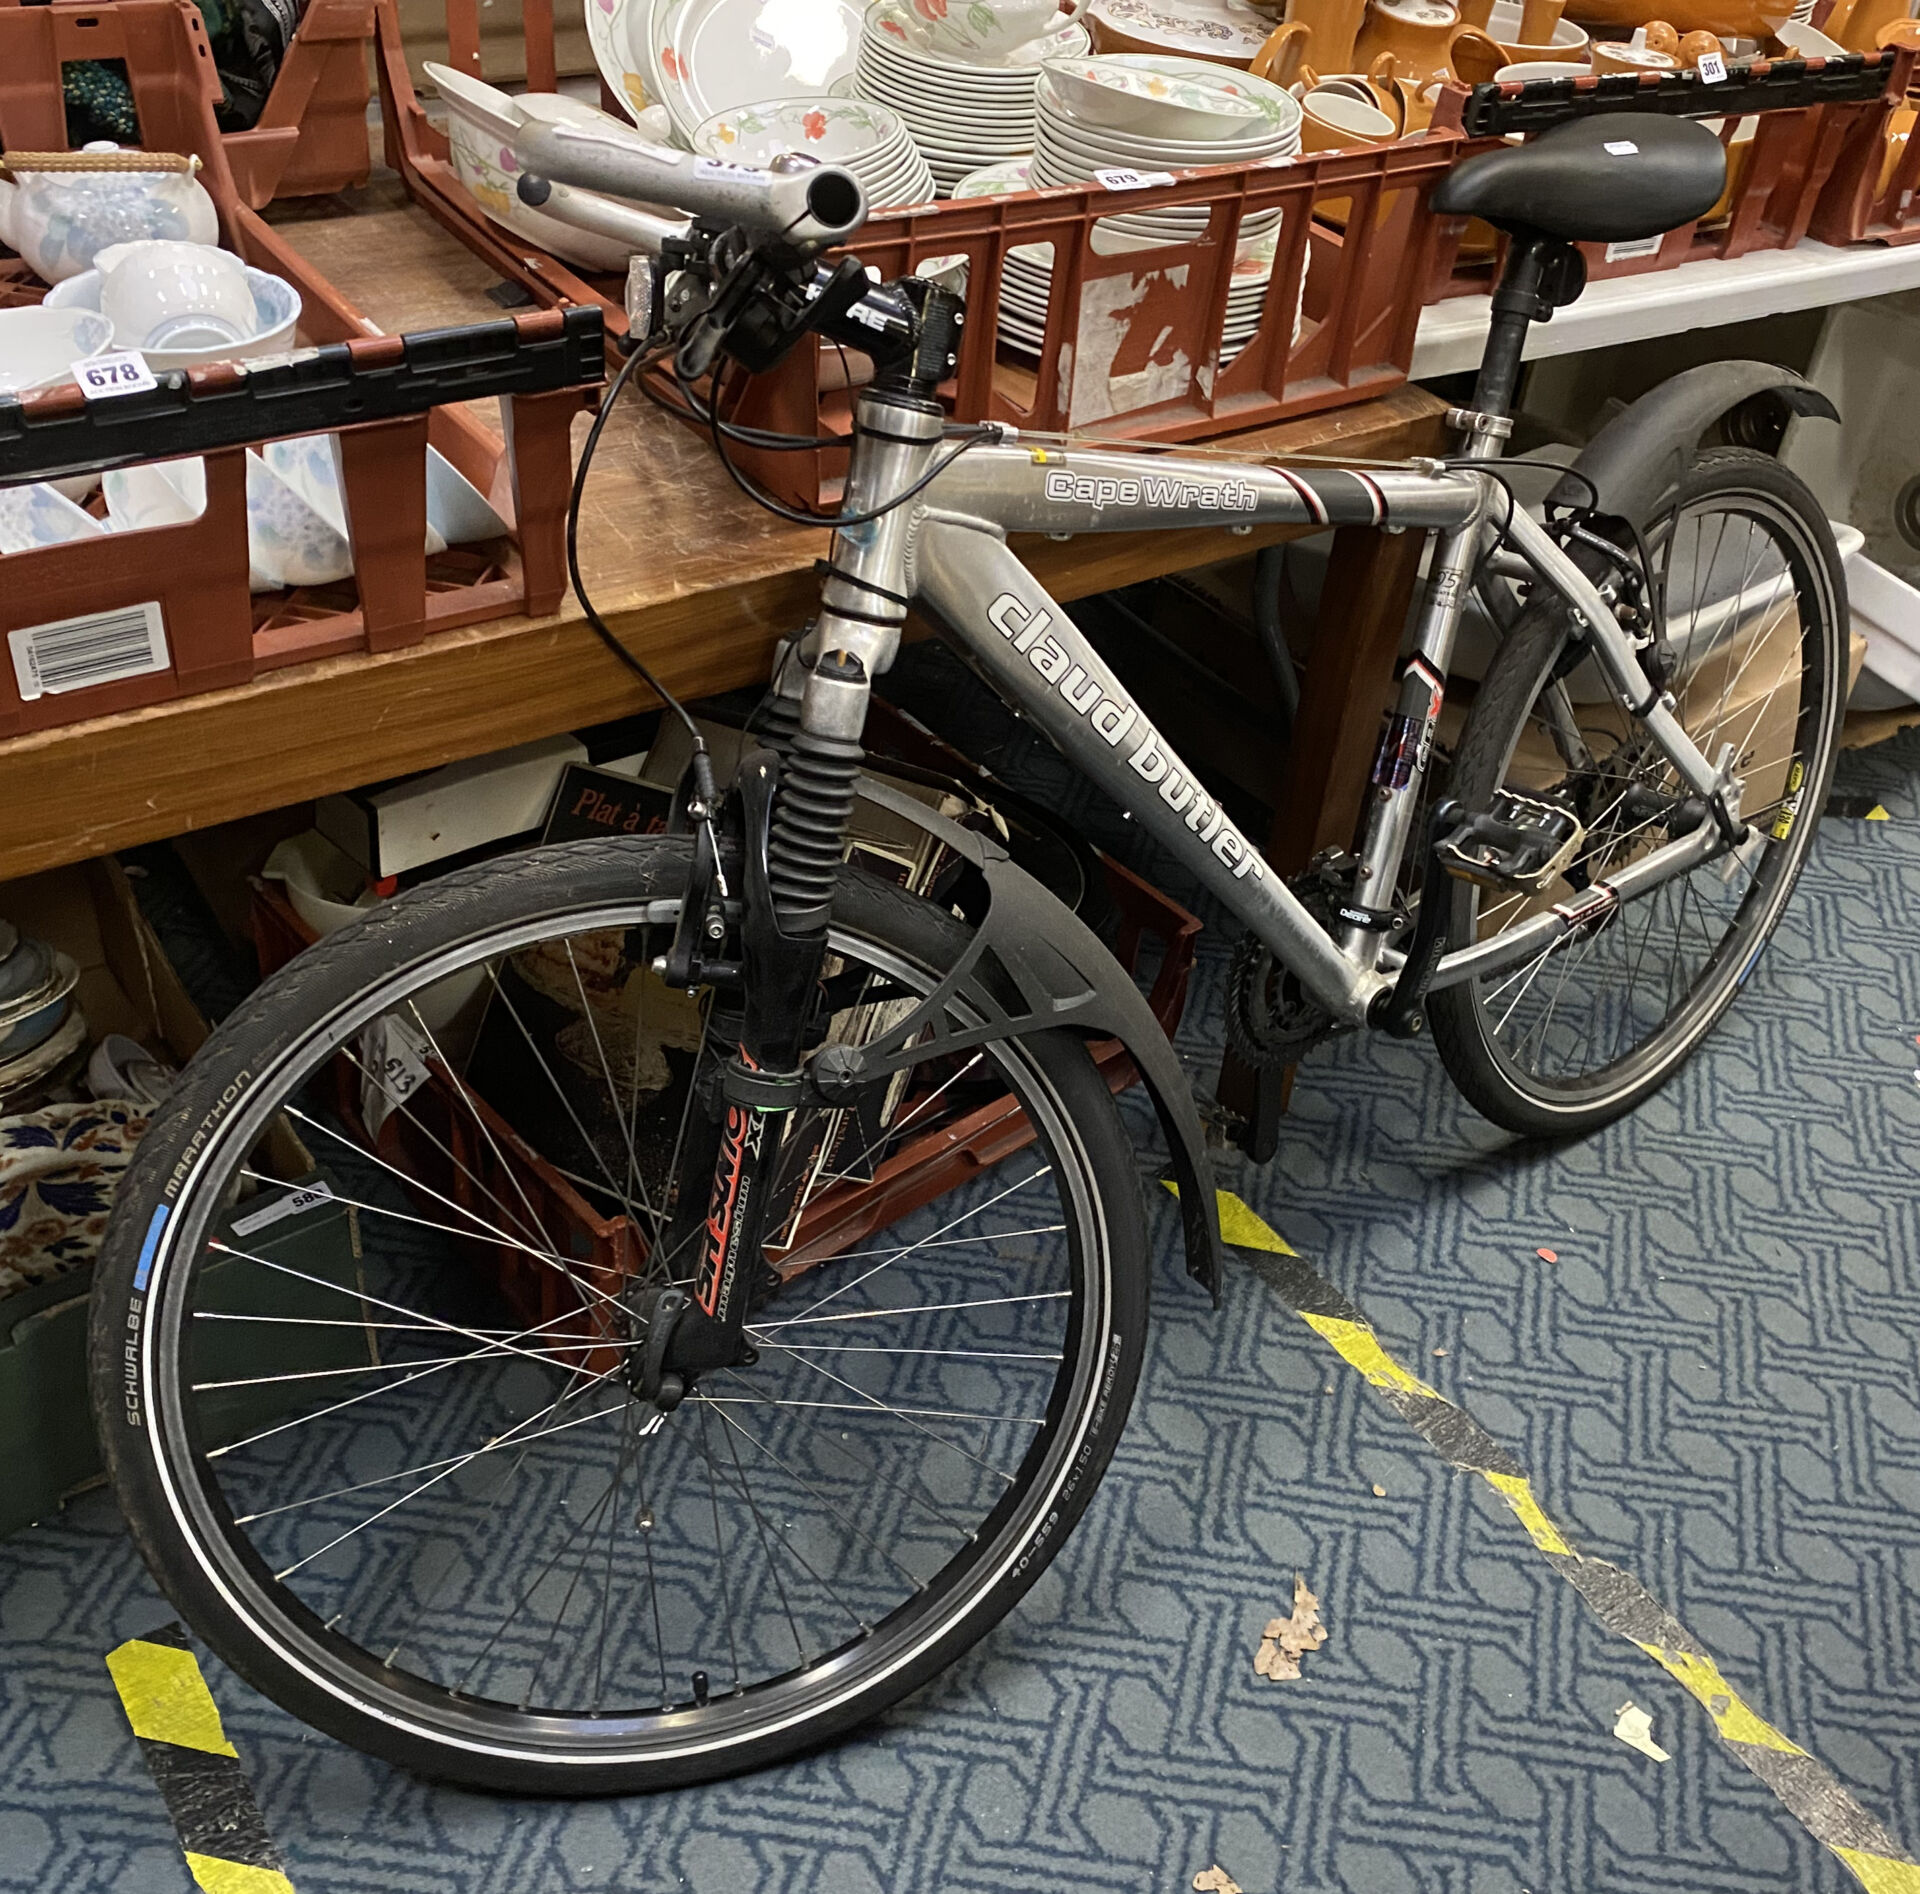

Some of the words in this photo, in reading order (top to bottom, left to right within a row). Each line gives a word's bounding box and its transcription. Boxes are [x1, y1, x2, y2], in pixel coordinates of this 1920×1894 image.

[1703, 62, 1721, 76] 301
[1105, 174, 1139, 185] 679
[86, 363, 140, 386] 678
[1045, 470, 1140, 510] Cape
[1141, 476, 1260, 511] Wrath
[987, 592, 1138, 748] claud
[1127, 727, 1264, 880] butler
[571, 788, 622, 825] Plat
[622, 801, 641, 832] à
[164, 1070, 251, 1198] MARATHON
[717, 1175, 750, 1322] magnesium
[125, 1297, 142, 1426] SCHWALBE
[1012, 1511, 1059, 1578] 40-559
